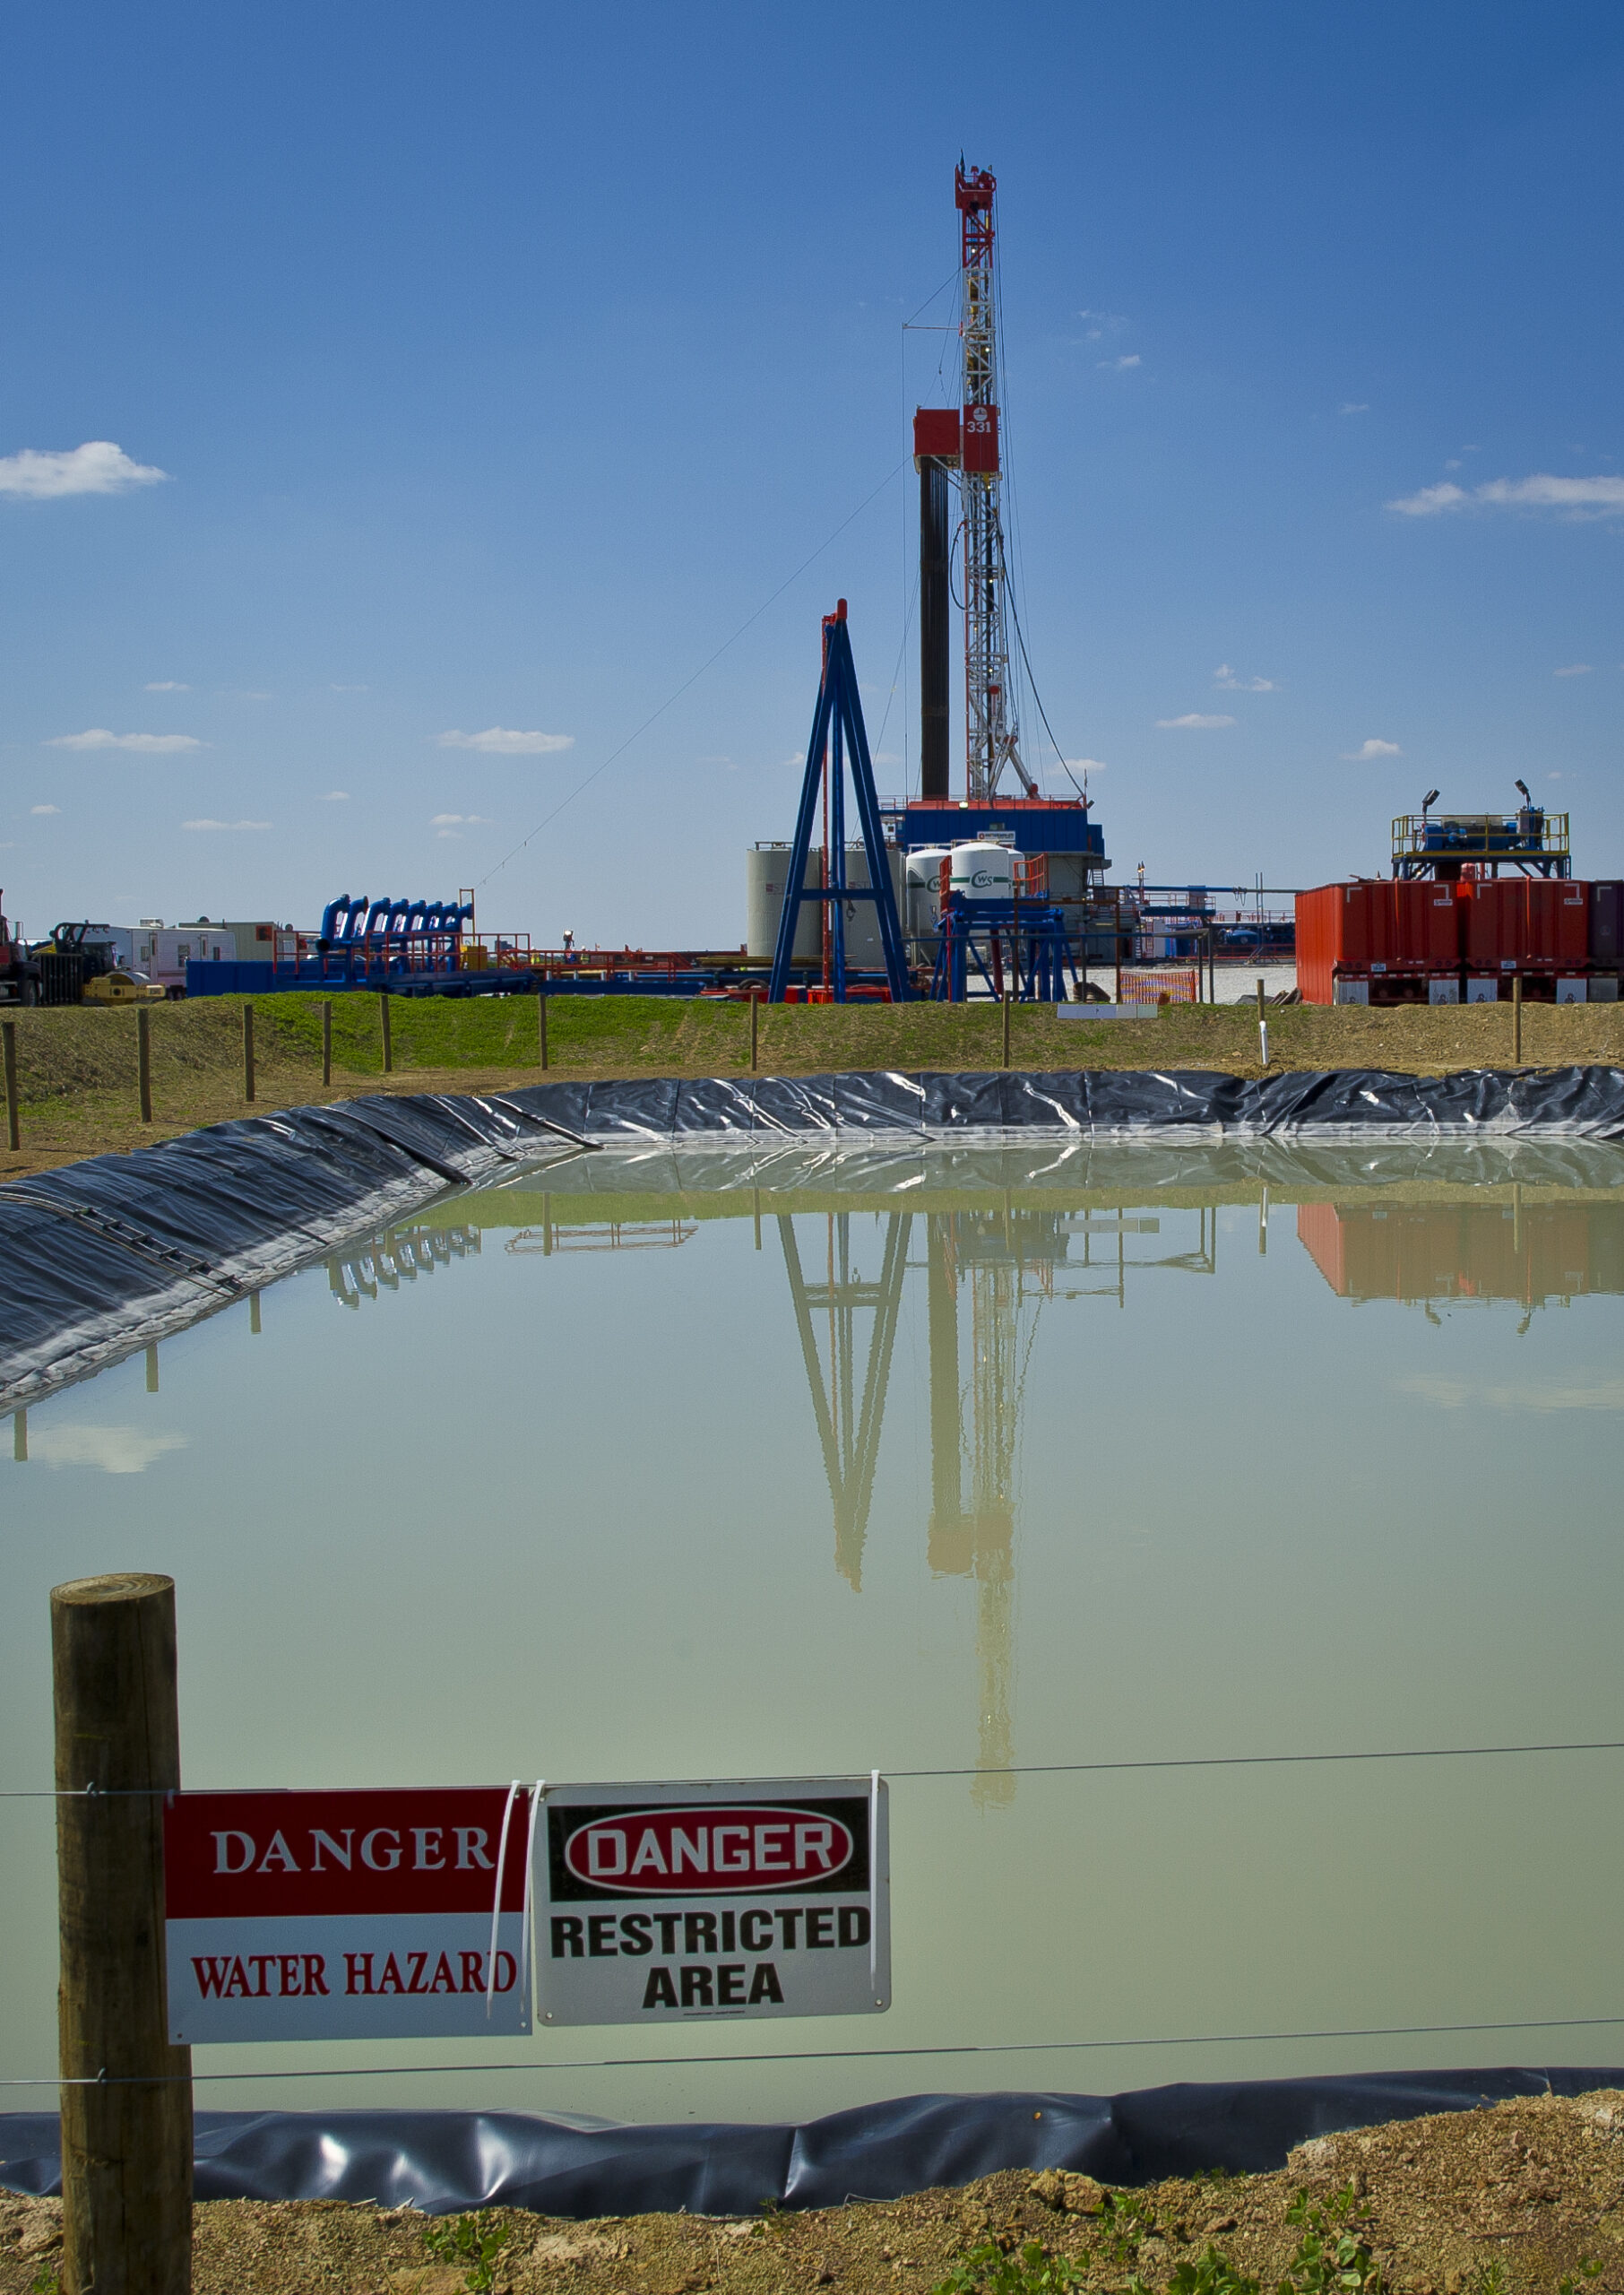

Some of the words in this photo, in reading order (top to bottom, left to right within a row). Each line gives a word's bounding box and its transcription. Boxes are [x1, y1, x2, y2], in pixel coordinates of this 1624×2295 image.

[967, 421, 991, 433] 331
[927, 875, 941, 893] CW
[211, 1827, 495, 1874] DANGER
[588, 1823, 833, 1876] DANGER
[550, 1906, 871, 1959] RESTRICTED
[191, 1953, 331, 1999] WATER
[342, 1950, 517, 1996] HAZARD
[642, 1962, 785, 2009] AREA
